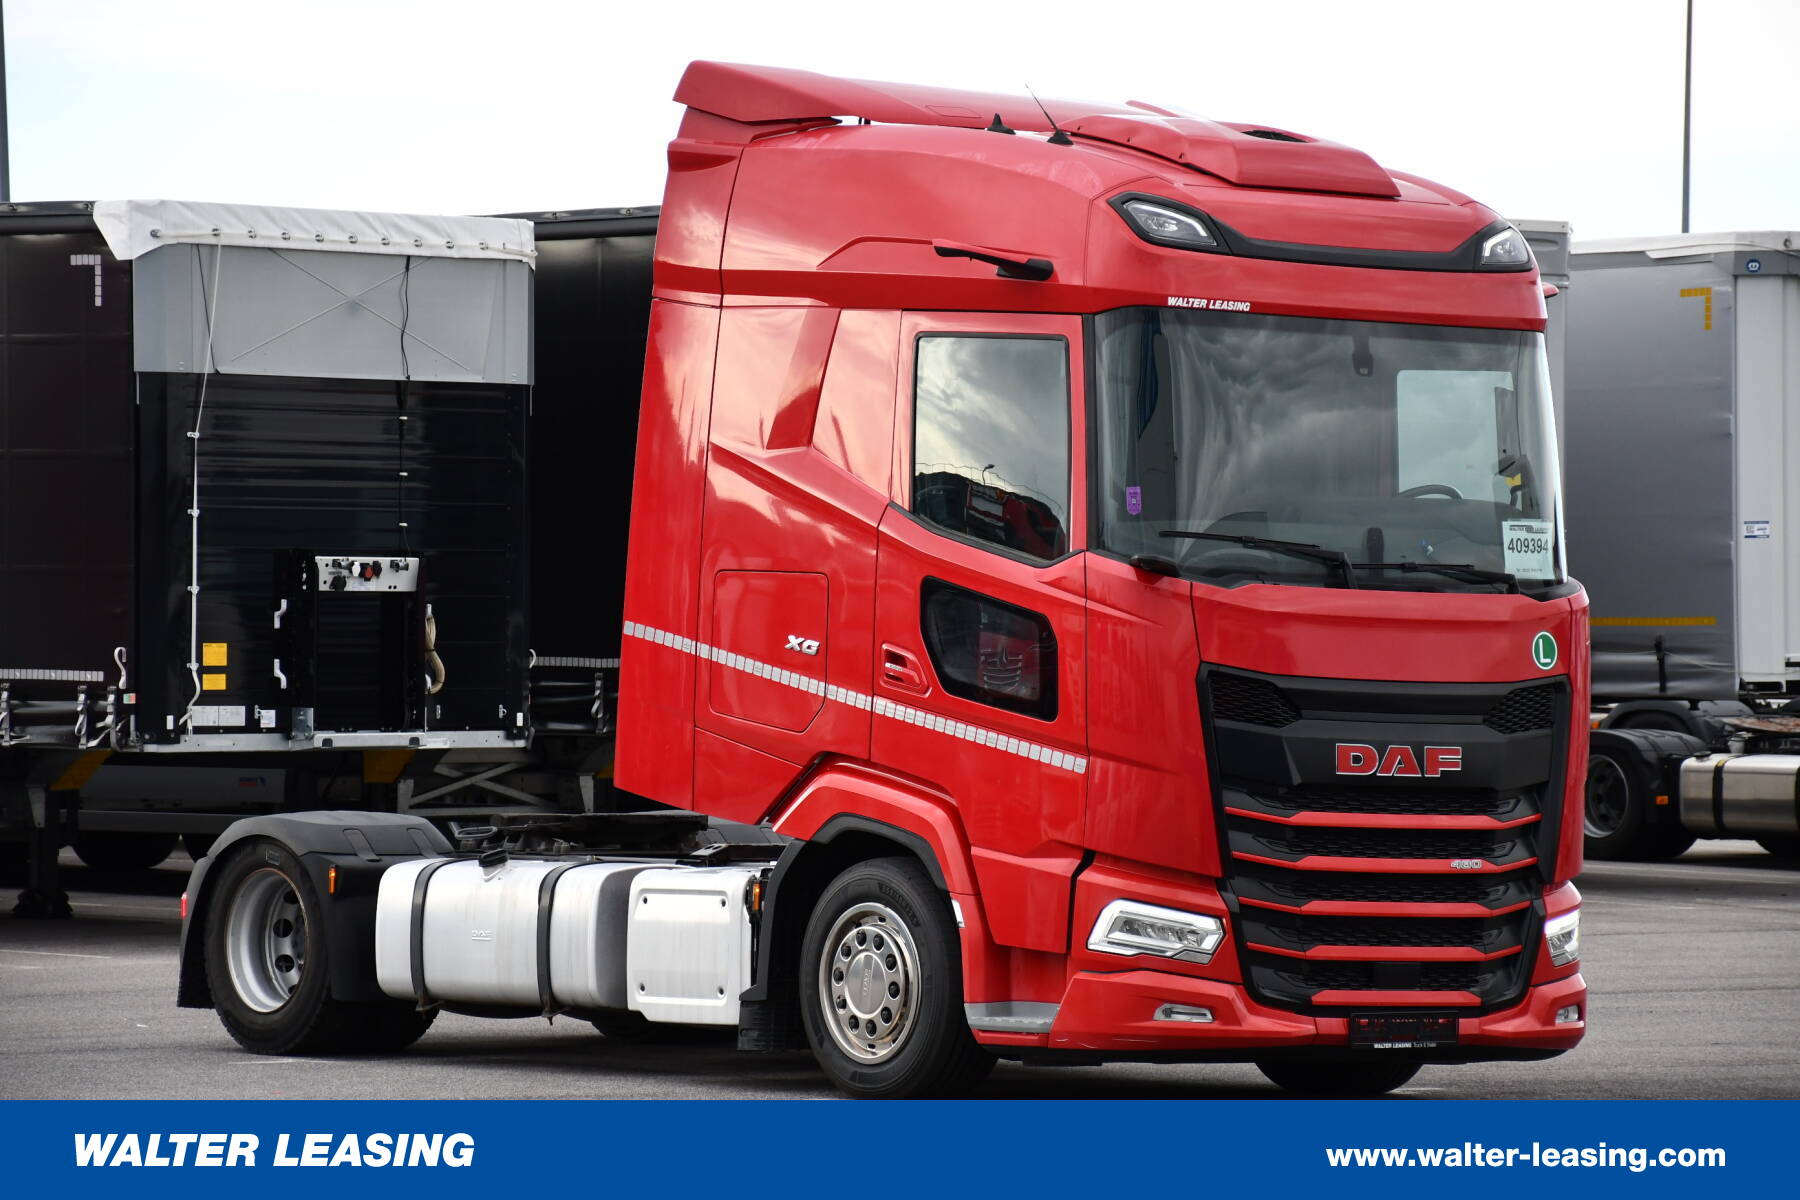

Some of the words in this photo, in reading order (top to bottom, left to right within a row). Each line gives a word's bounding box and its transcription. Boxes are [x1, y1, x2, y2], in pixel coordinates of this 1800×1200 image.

[1167, 296, 1208, 308] WALTER
[1208, 299, 1251, 312] LEASING
[1508, 537, 1549, 554] 409394
[784, 635, 820, 656] XG
[1538, 638, 1552, 663] L
[1335, 743, 1463, 778] DAF
